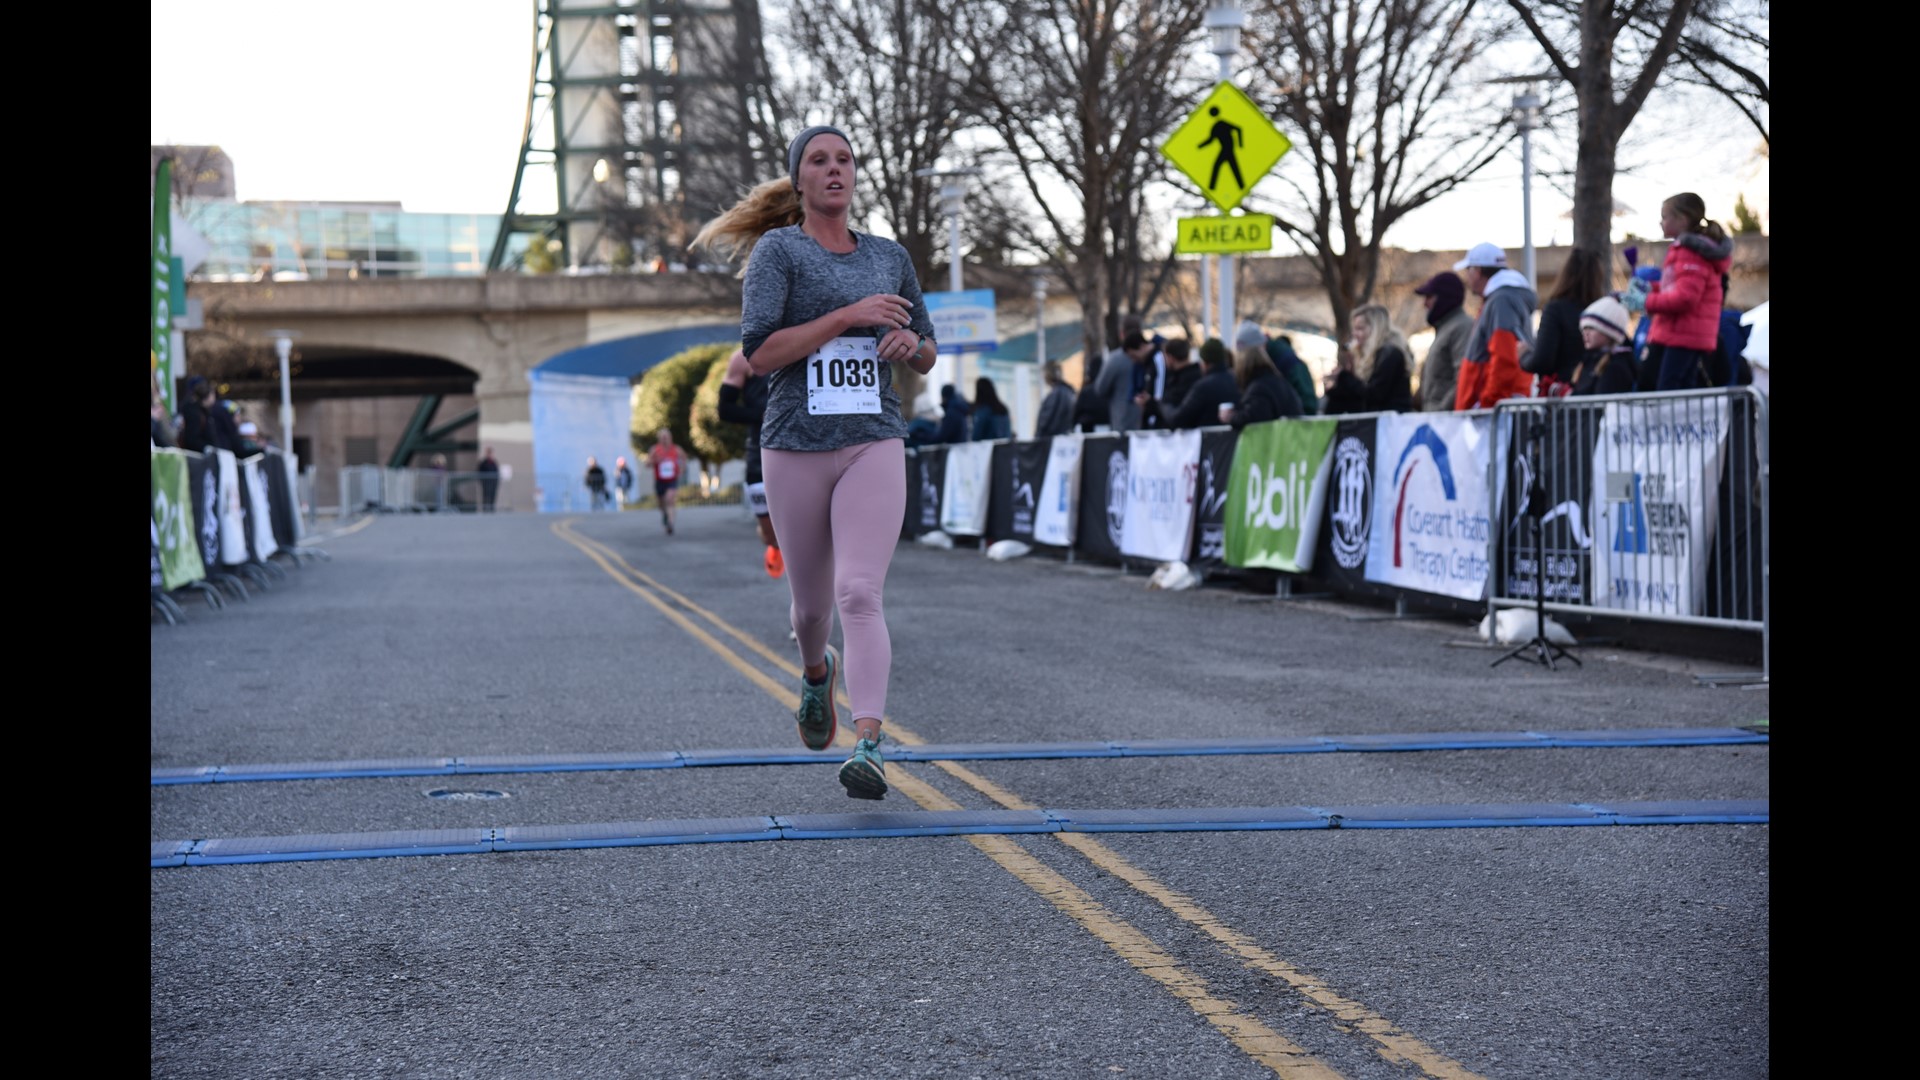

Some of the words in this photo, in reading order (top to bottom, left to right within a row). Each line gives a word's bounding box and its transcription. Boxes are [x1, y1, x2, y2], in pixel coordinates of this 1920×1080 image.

[1189, 223, 1262, 243] AHEAD
[812, 358, 876, 388] 1033
[1244, 459, 1316, 531] Publi
